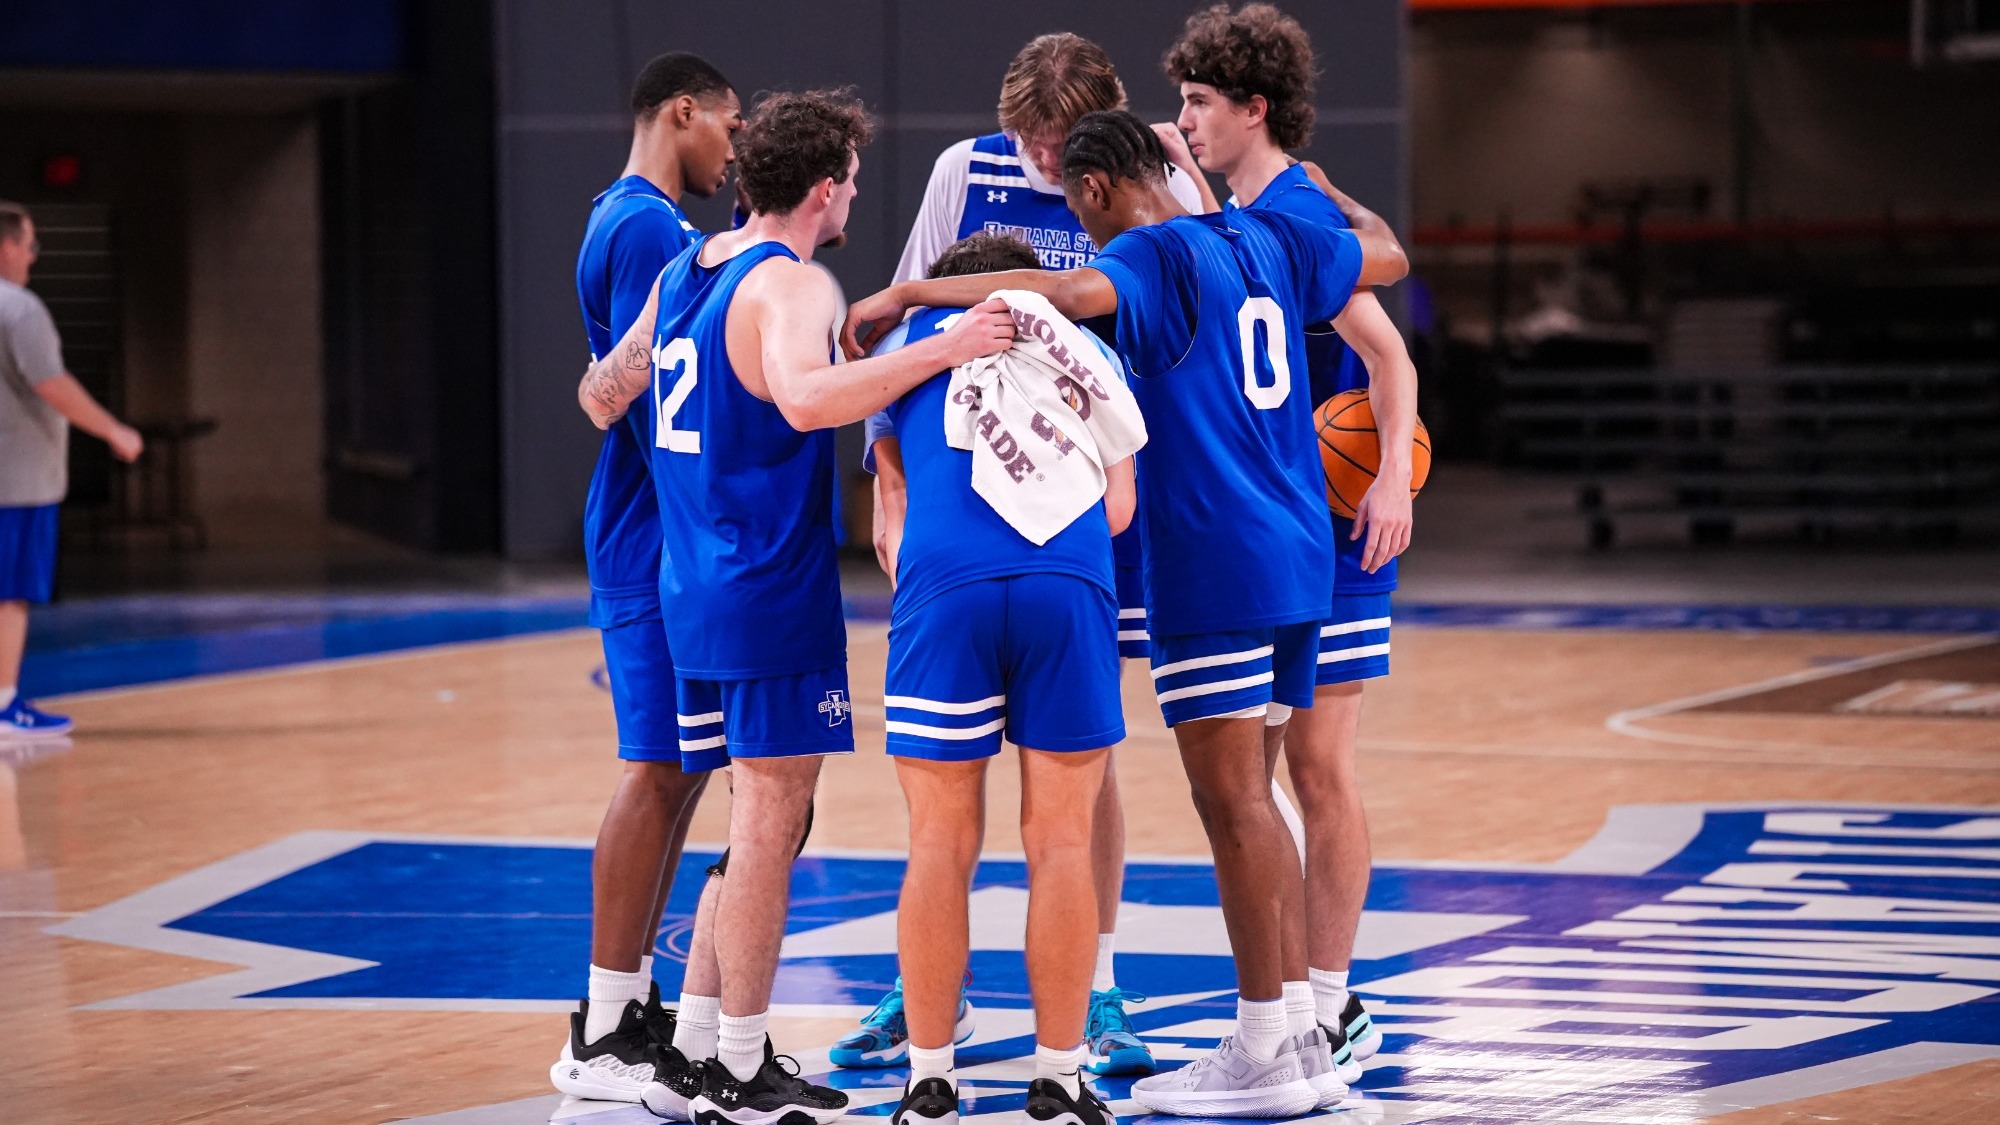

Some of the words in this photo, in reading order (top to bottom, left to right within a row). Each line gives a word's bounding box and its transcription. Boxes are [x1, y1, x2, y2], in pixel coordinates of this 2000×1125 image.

[652, 334, 701, 454] 12
[1007, 306, 1111, 401] GATOR
[1238, 296, 1291, 410] 0
